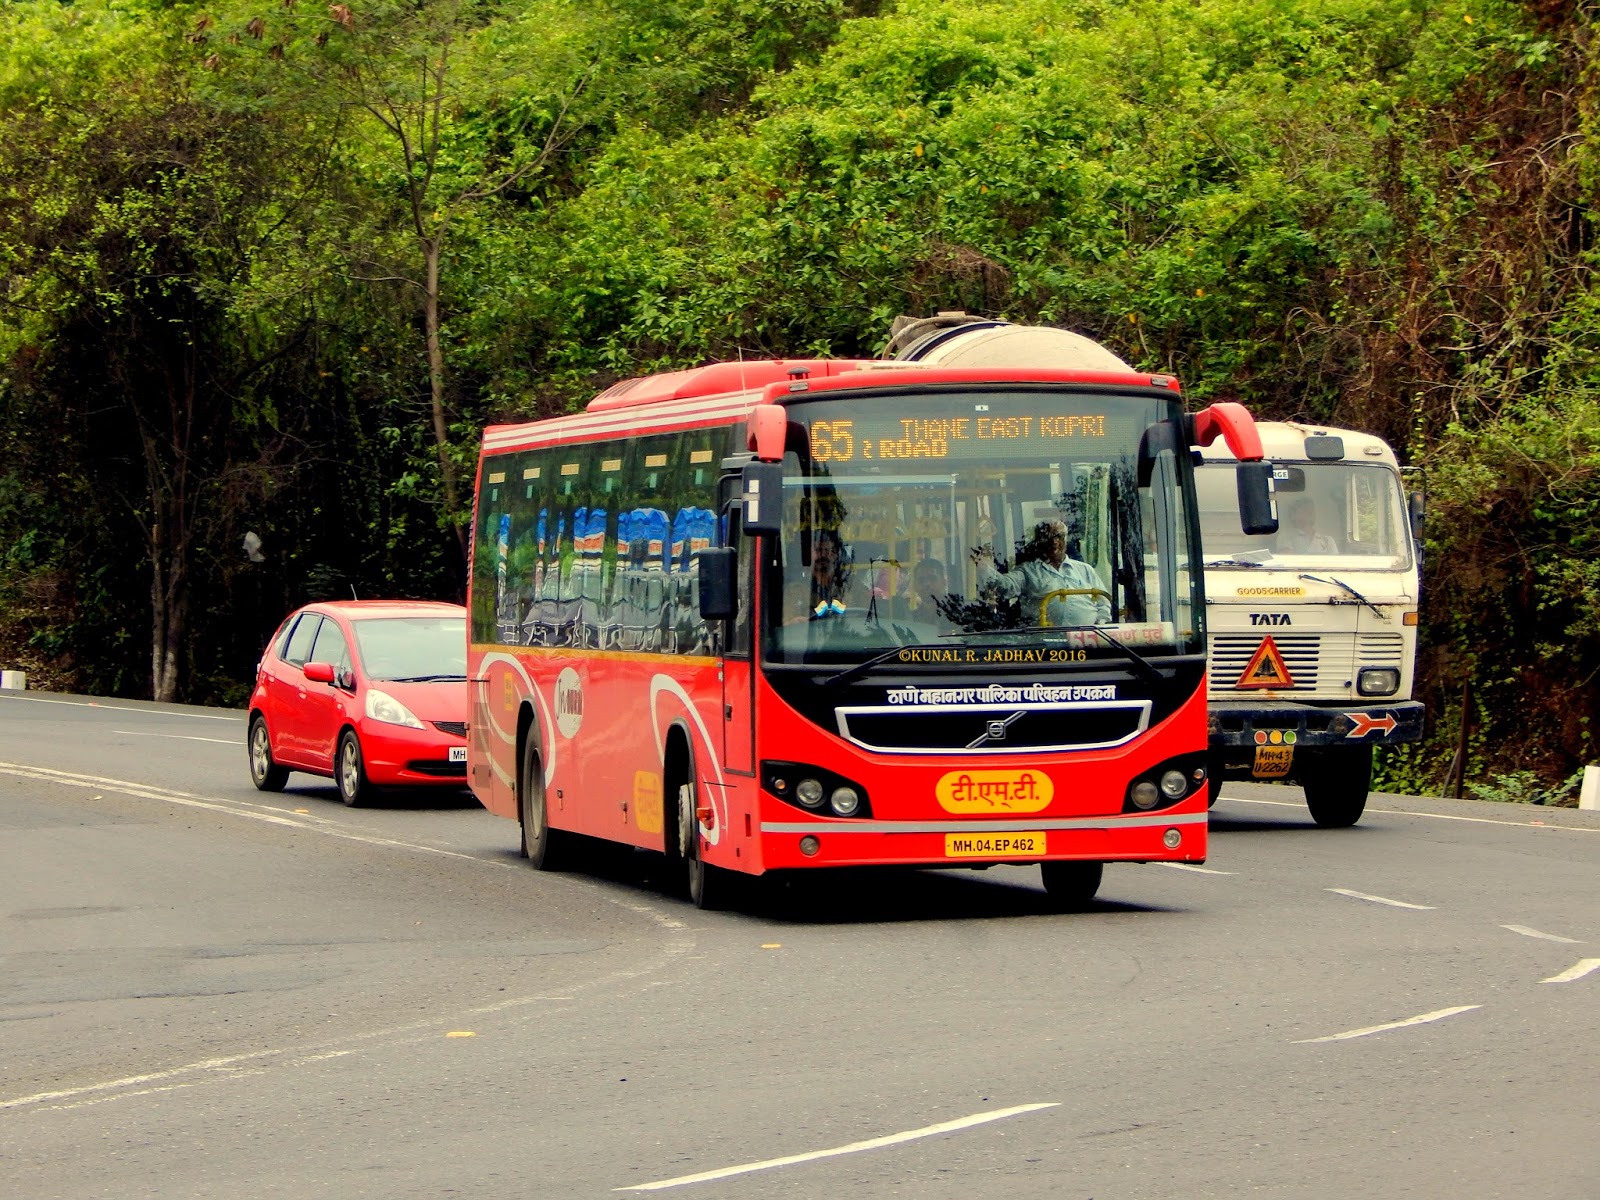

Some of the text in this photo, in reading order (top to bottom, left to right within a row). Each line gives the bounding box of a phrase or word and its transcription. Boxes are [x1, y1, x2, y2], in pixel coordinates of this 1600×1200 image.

[900, 415, 1105, 440] THANE EAST KOPRI
[810, 420, 853, 461] 65
[879, 439, 947, 458] ROAD
[1249, 613, 1292, 626] TATA
[886, 685, 919, 704] ठाणे
[1022, 683, 1073, 703] परिवहन
[1072, 684, 1116, 701] उपक्रम
[453, 750, 466, 760] MH
[953, 838, 1034, 852] MH.04.EP 462
